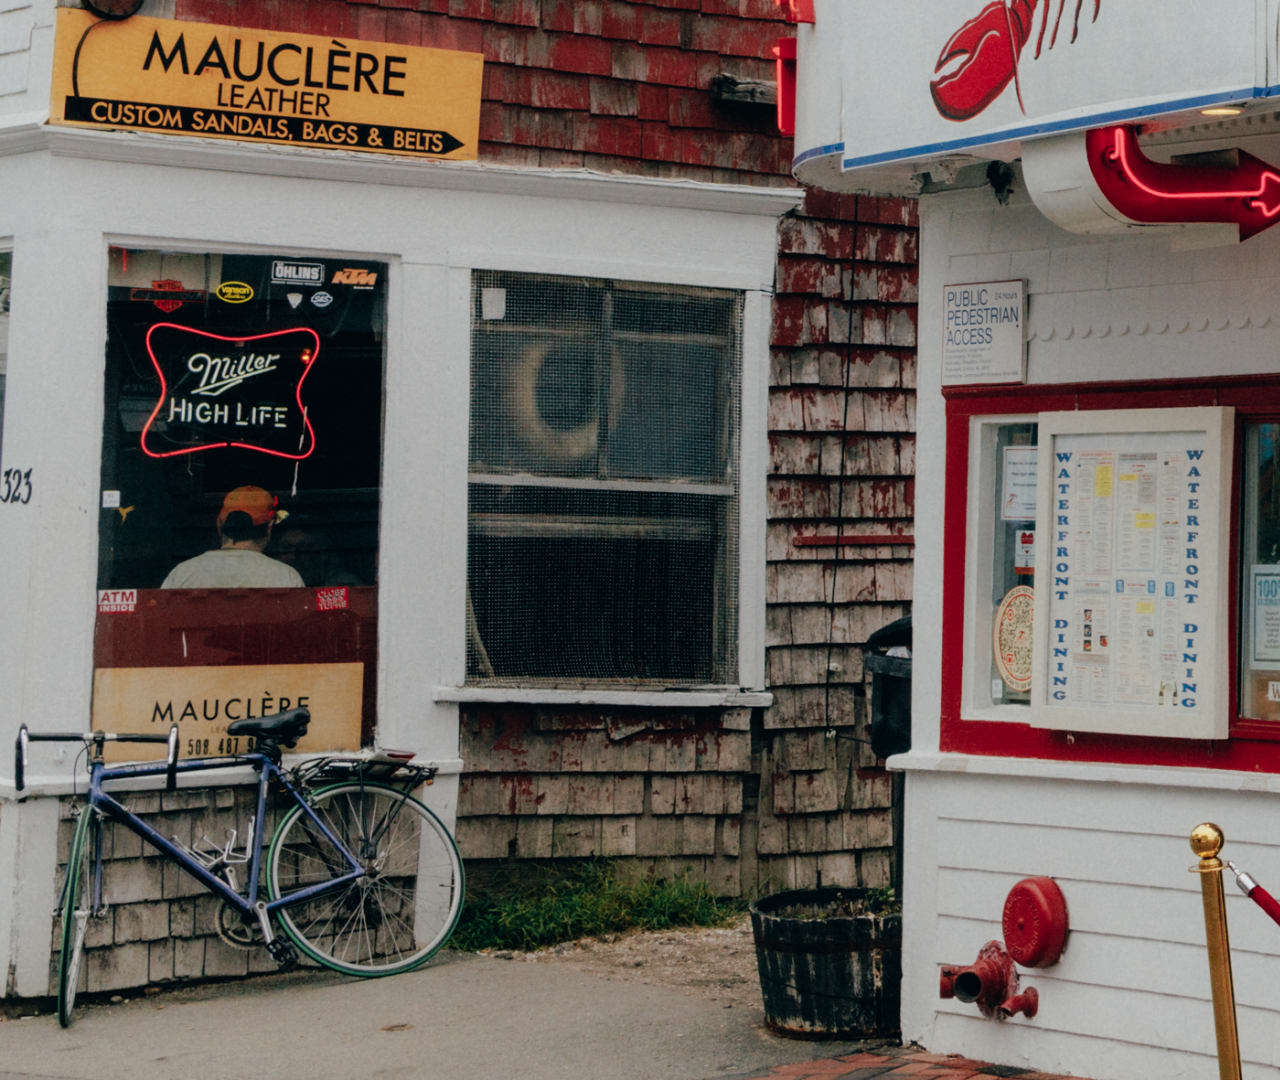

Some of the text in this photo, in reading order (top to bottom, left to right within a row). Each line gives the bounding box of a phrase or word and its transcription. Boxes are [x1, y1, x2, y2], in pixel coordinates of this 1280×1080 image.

[143, 29, 407, 97] MAUCLÈRE
[217, 83, 330, 117] LEATHER
[90, 101, 443, 152] CUSTOM SANDALS, BAGS & BELTS
[275, 262, 320, 280] ÖHLINS
[331, 268, 377, 285] KTM
[947, 289, 988, 308] PUBLIC
[947, 306, 1019, 327] PEDESTRIAN
[946, 327, 993, 345] ACCESS
[188, 353, 280, 388] Miller
[168, 397, 288, 427] HIGH LIFE
[0, 468, 32, 505] 323
[1053, 452, 1073, 701] WATERFRONT DINING
[1182, 450, 1204, 708] WATERFRONT DINING
[99, 604, 135, 612] INSIDE
[101, 591, 135, 604] ATM
